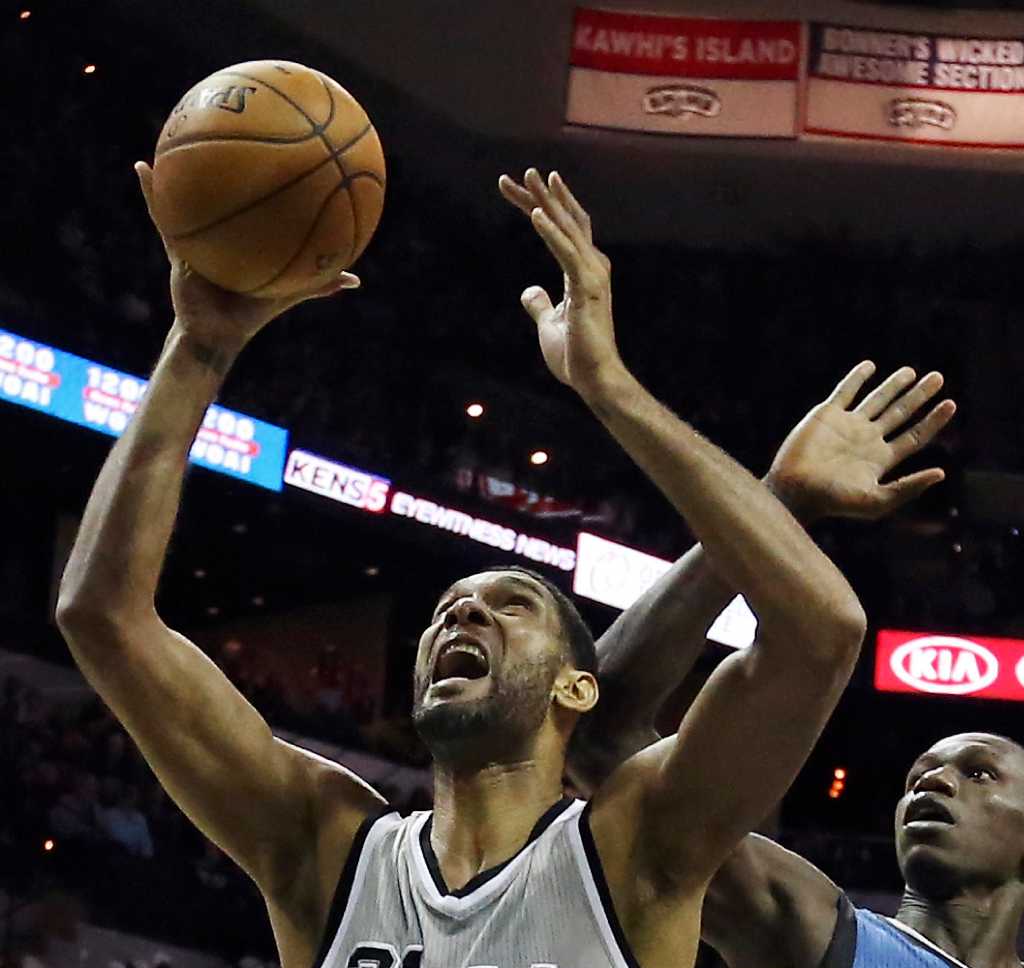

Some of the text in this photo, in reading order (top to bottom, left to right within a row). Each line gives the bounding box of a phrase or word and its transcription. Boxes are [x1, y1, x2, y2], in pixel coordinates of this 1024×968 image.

[575, 25, 796, 64] KAWHI'S ISLAND
[0, 334, 55, 371] 200
[391, 491, 577, 571] EYEWITNESS NEWS
